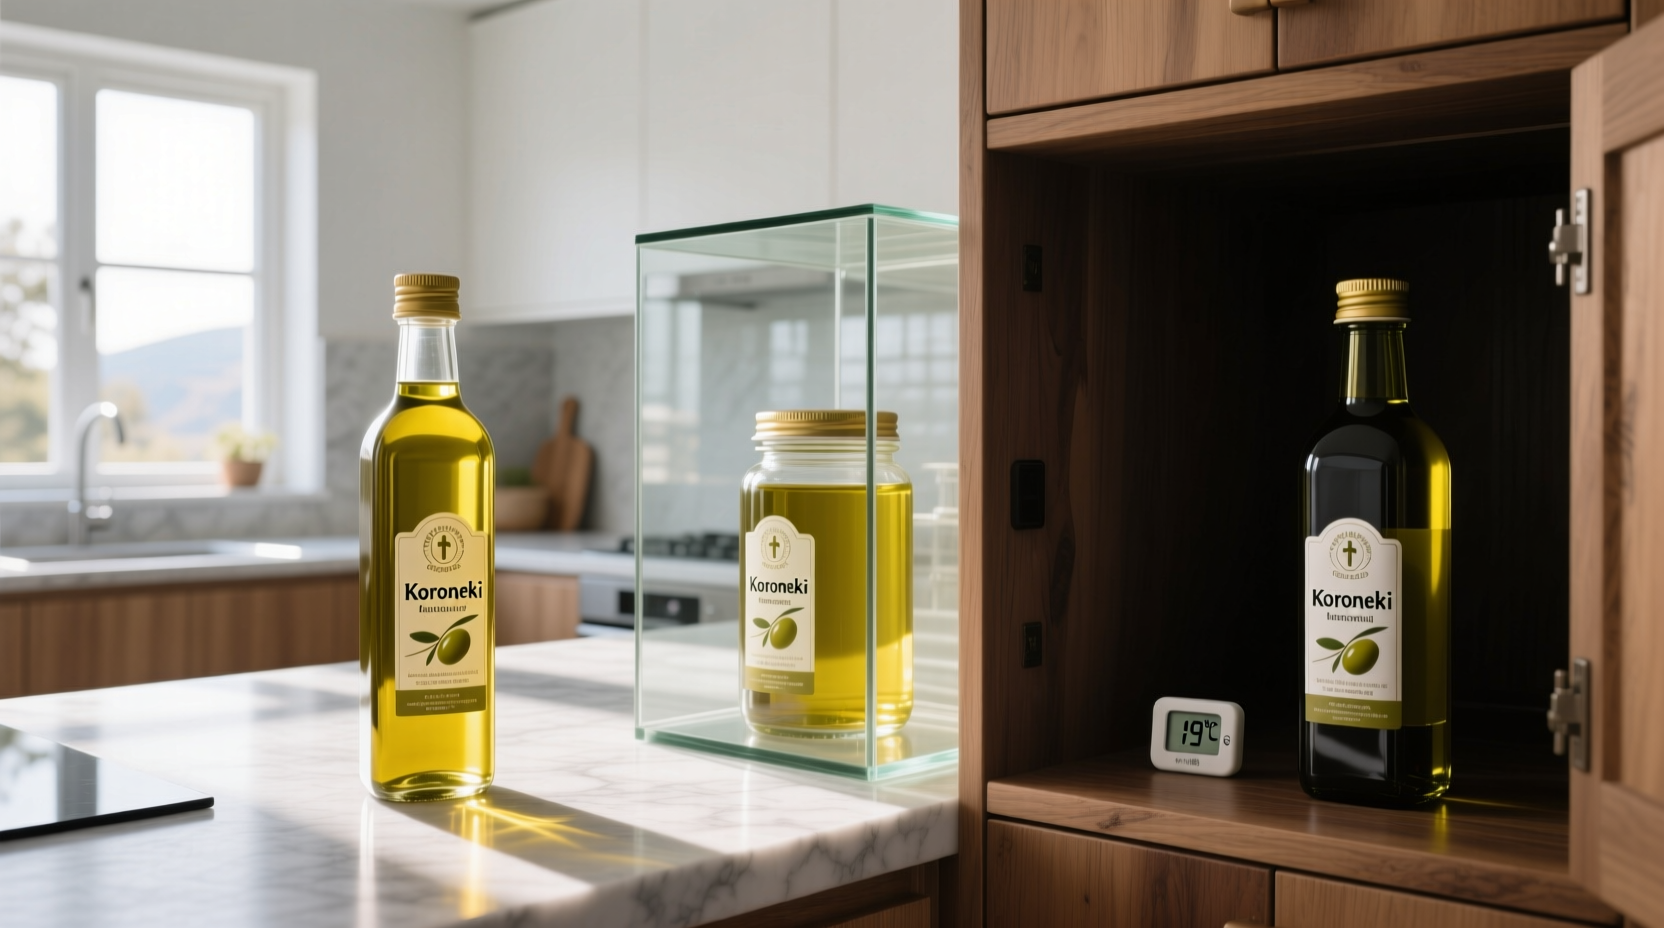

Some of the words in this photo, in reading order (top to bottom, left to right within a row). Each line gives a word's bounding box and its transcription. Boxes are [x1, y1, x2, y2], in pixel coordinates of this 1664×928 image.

[405, 580, 483, 601] Koroneki
[749, 575, 808, 594] Koroneki
[1312, 588, 1392, 610] Koroneki
